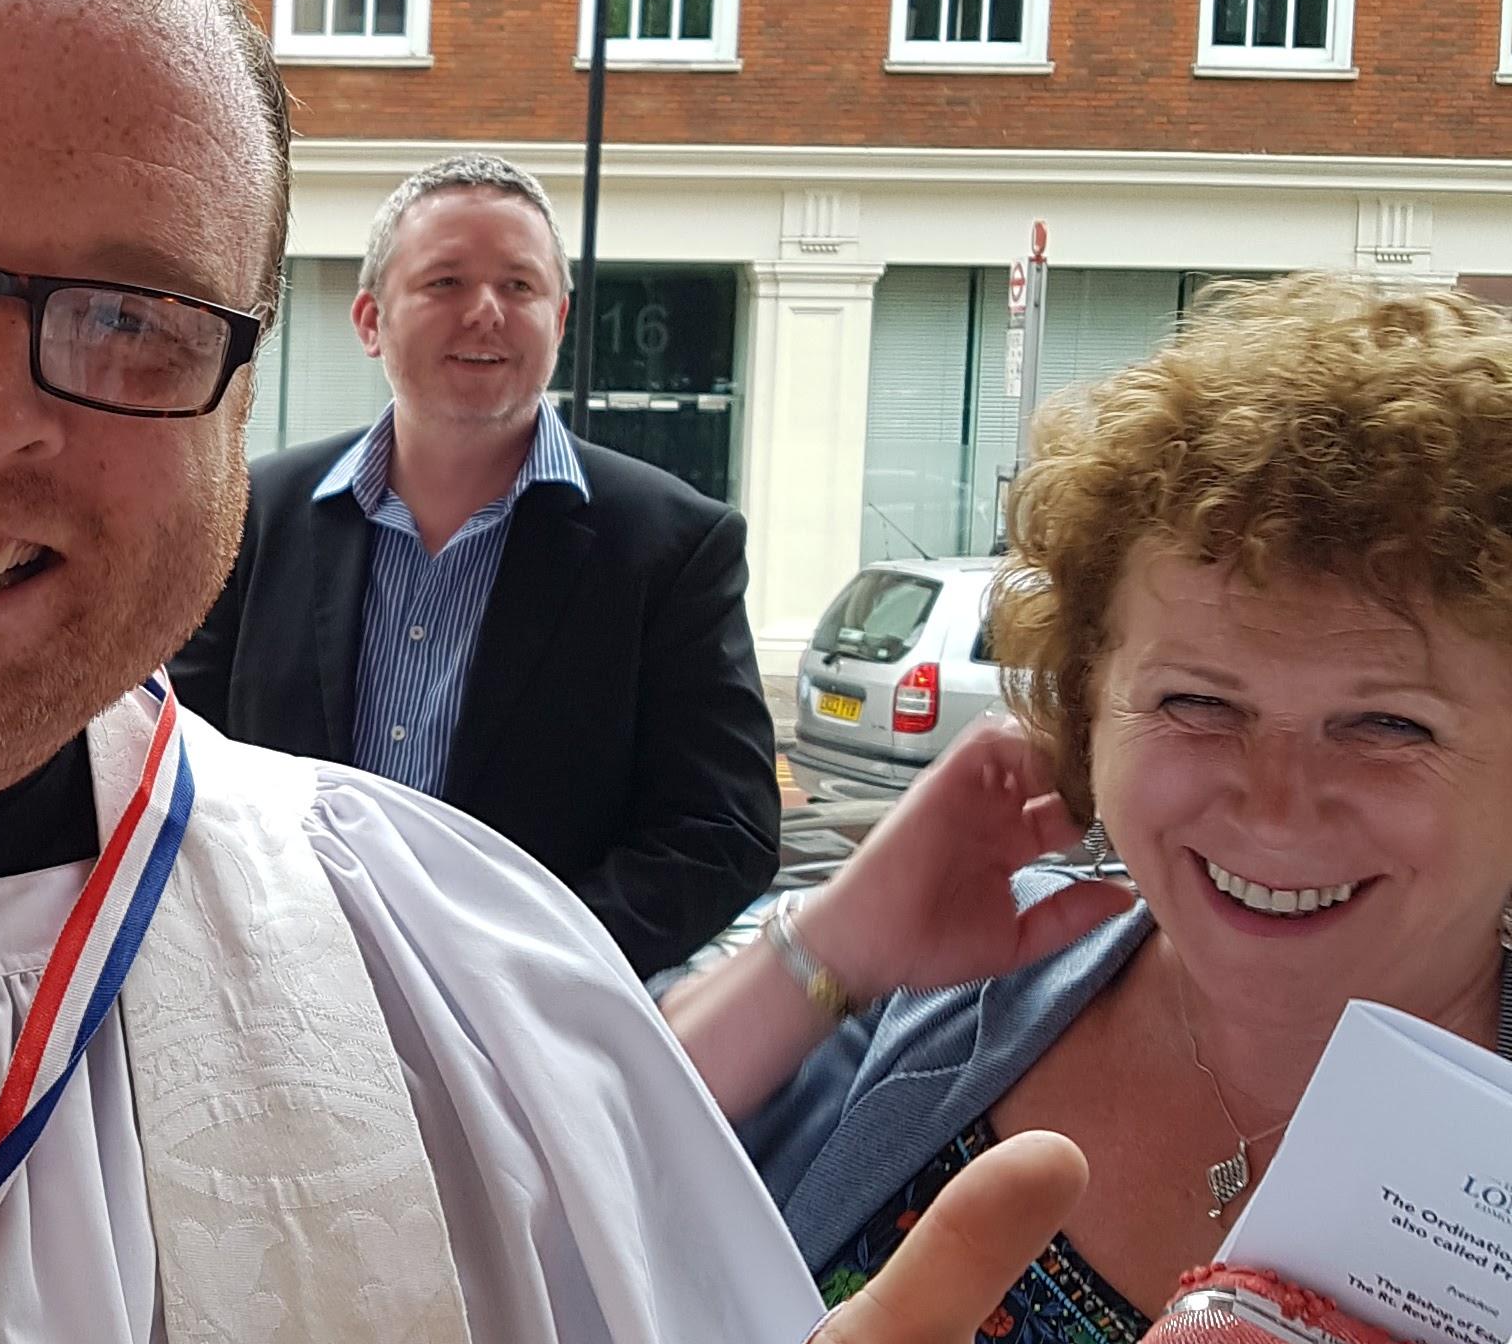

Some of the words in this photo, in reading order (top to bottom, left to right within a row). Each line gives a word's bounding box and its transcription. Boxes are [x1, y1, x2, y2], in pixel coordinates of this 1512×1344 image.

[600, 303, 668, 354] 16
[1459, 1175, 1512, 1214] LO
[1381, 1185, 1415, 1212] The
[1421, 1209, 1512, 1264] Ordinatio
[1391, 1215, 1427, 1238] also
[1433, 1236, 1488, 1267] called
[1347, 1271, 1374, 1294] The
[1375, 1273, 1402, 1295] The
[1407, 1290, 1453, 1321] Bishop
[1457, 1318, 1474, 1330] of
